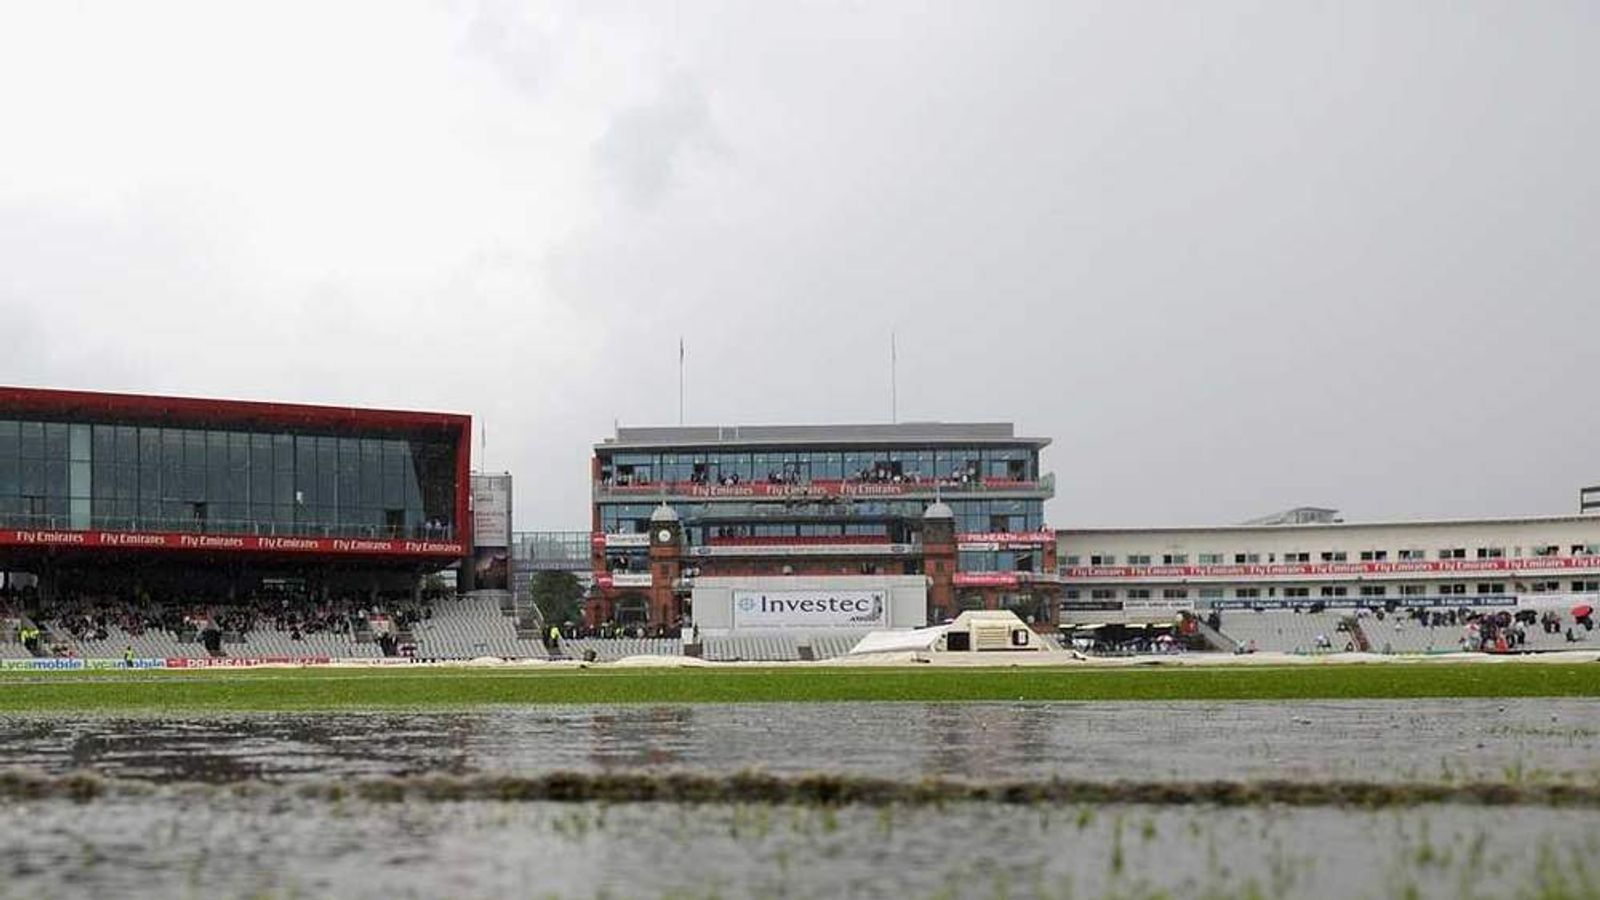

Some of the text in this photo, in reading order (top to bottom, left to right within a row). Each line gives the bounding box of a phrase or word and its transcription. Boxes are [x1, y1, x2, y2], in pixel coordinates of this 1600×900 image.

[692, 485, 753, 496] Fly Emirates
[767, 485, 783, 496] Fly
[840, 483, 900, 495] Fly Emirates
[17, 531, 84, 543] Fly Emirates
[101, 532, 165, 544] Fly Emirates
[181, 535, 244, 547] Fly Emirates
[258, 537, 319, 549] Fly Emirates
[333, 539, 391, 551] Fly Emirates
[406, 541, 461, 552] Fly Emirates
[1504, 560, 1565, 570] Fly Emirates
[1571, 558, 1588, 568] Fly
[1250, 565, 1265, 575] Fly
[761, 595, 869, 612] Investec
[0, 658, 81, 670] Lycamobile
